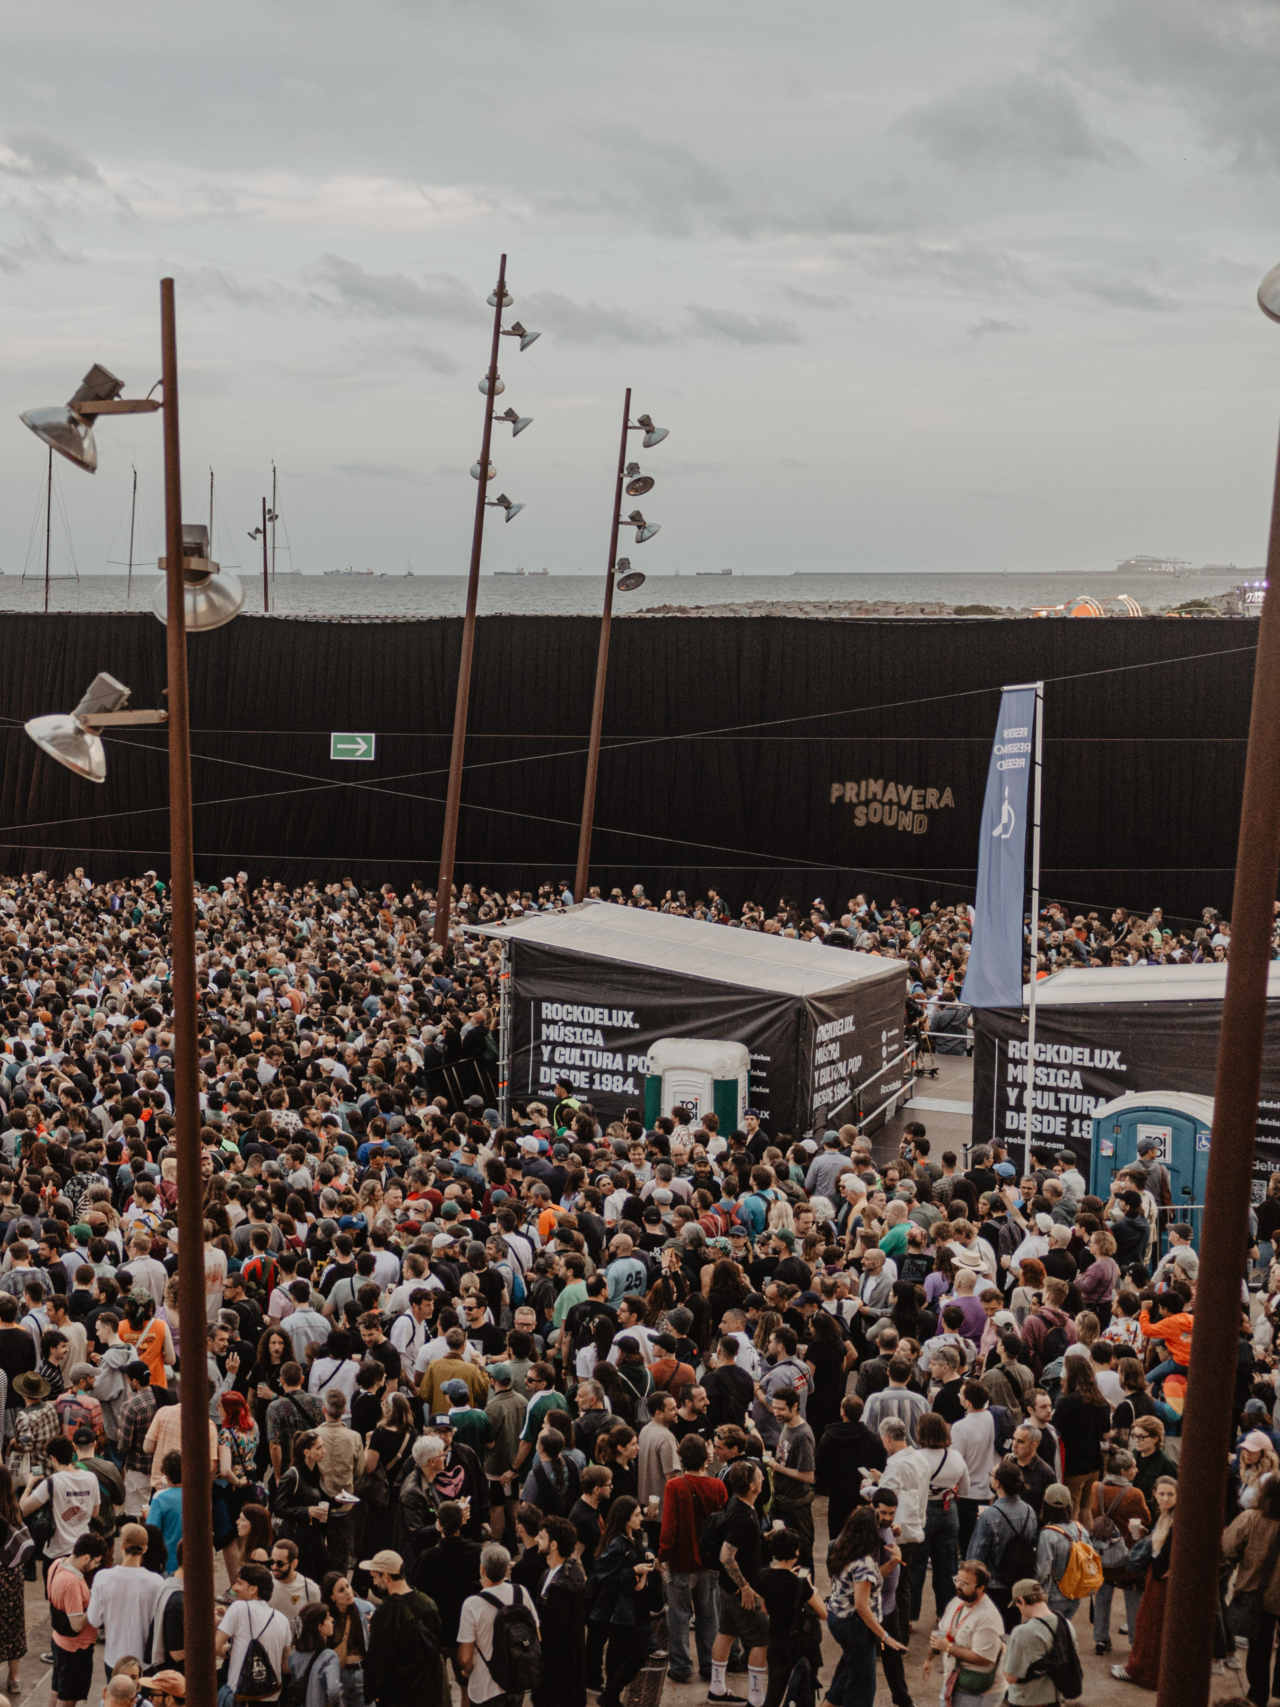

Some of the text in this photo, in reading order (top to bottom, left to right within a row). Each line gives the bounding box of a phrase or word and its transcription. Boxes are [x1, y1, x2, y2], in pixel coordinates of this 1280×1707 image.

[830, 778, 955, 810] PRIMAVERA
[854, 801, 928, 834] SOUND
[541, 1002, 640, 1029] ROCKDELUX.
[541, 1021, 604, 1047] MÚSICA
[540, 1045, 649, 1074] Y CULTURA PO
[847, 1055, 862, 1075] POP
[1008, 1040, 1127, 1071] ROCKDELUX.
[539, 1066, 640, 1096] DESDE 1984.
[1007, 1087, 1020, 1106] Y
[1006, 1111, 1093, 1139] DESDE 19
[624, 1271, 642, 1291] 25
